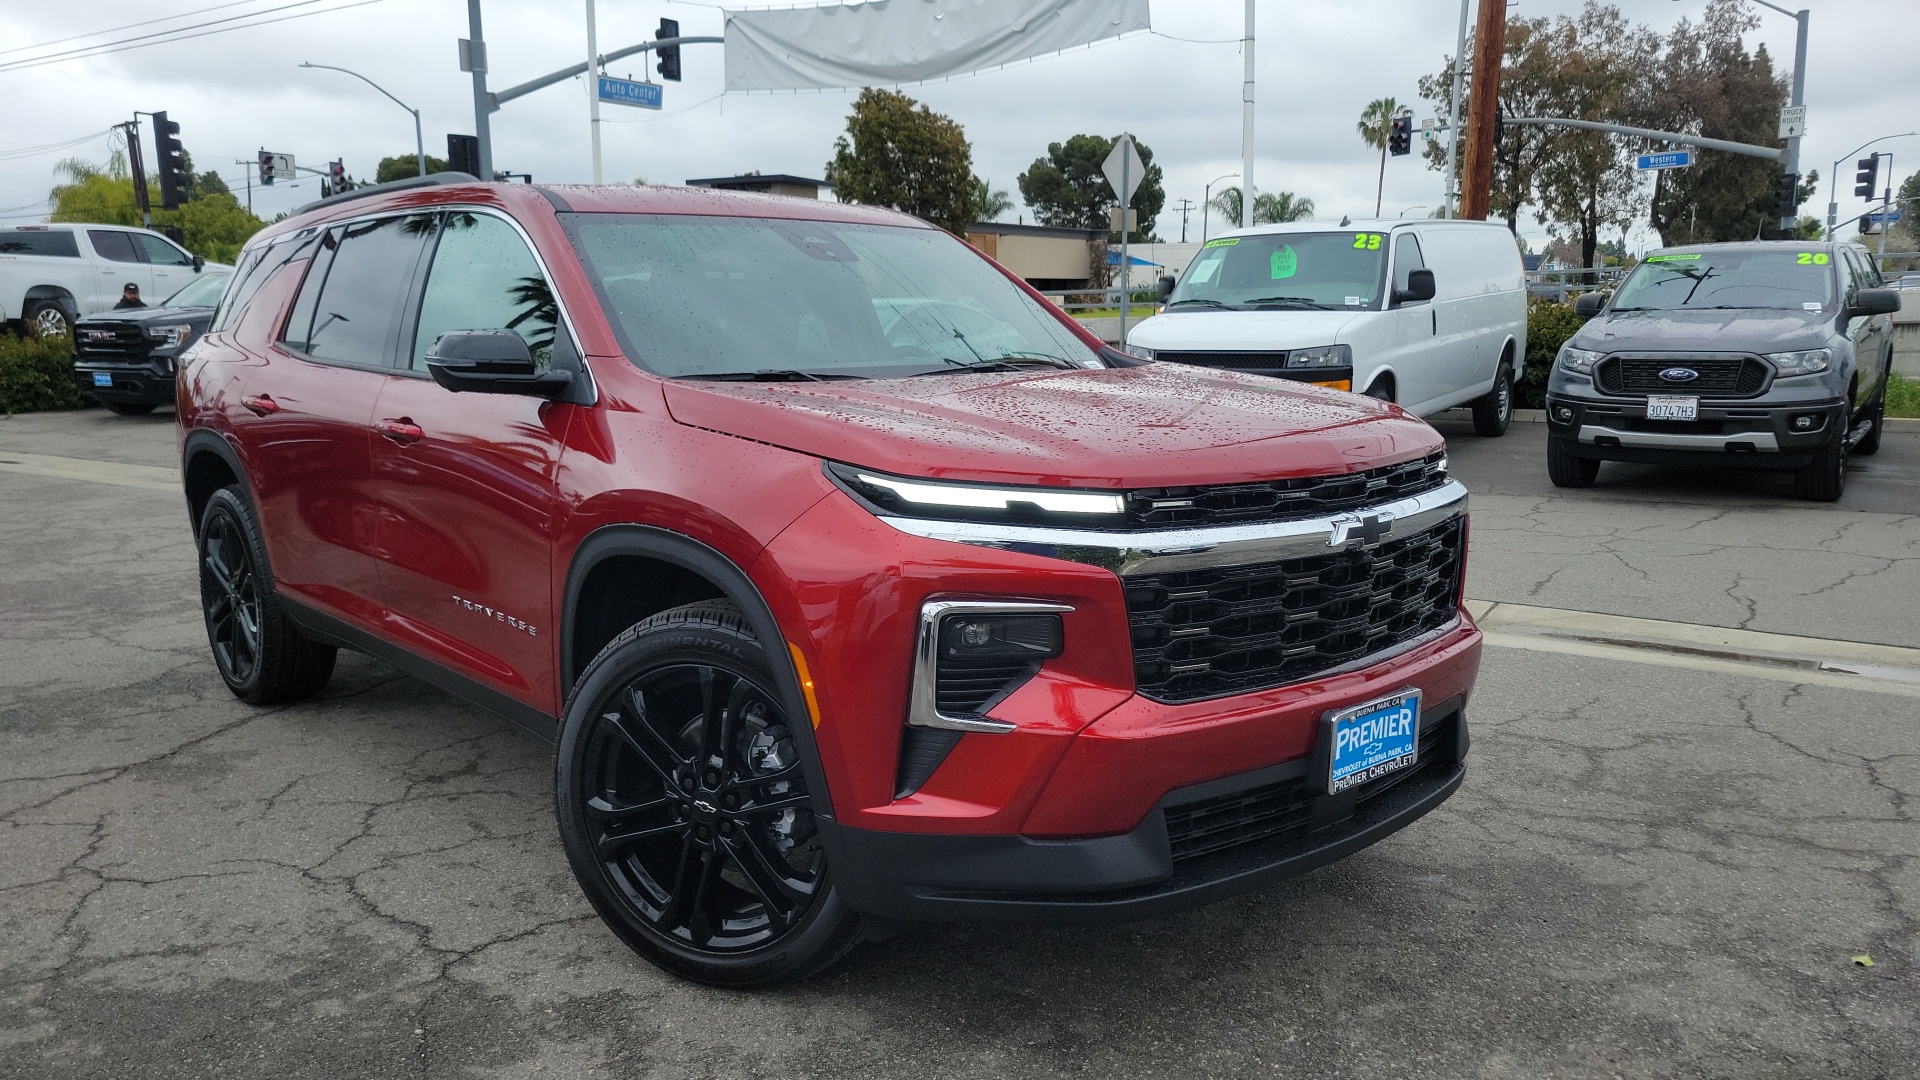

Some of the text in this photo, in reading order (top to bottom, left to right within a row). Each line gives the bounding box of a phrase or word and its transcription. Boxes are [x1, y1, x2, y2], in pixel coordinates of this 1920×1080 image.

[605, 81, 657, 100] Auto Center
[1783, 108, 1803, 116] TRUCK
[1649, 155, 1677, 164] Western
[1353, 233, 1382, 250] 23
[1796, 252, 1829, 265] 20
[1667, 370, 1689, 379] Ford
[1650, 404, 1694, 417] 30747H3
[452, 595, 537, 636] TRAVERSE
[1356, 706, 1375, 718] BUENA
[1391, 698, 1400, 708] CA
[1334, 708, 1412, 761] PREMIER
[1333, 743, 1413, 778] CHEVROLET of BUENA PARK, CA
[1334, 755, 1413, 792] PREMIER CHEVROLET
